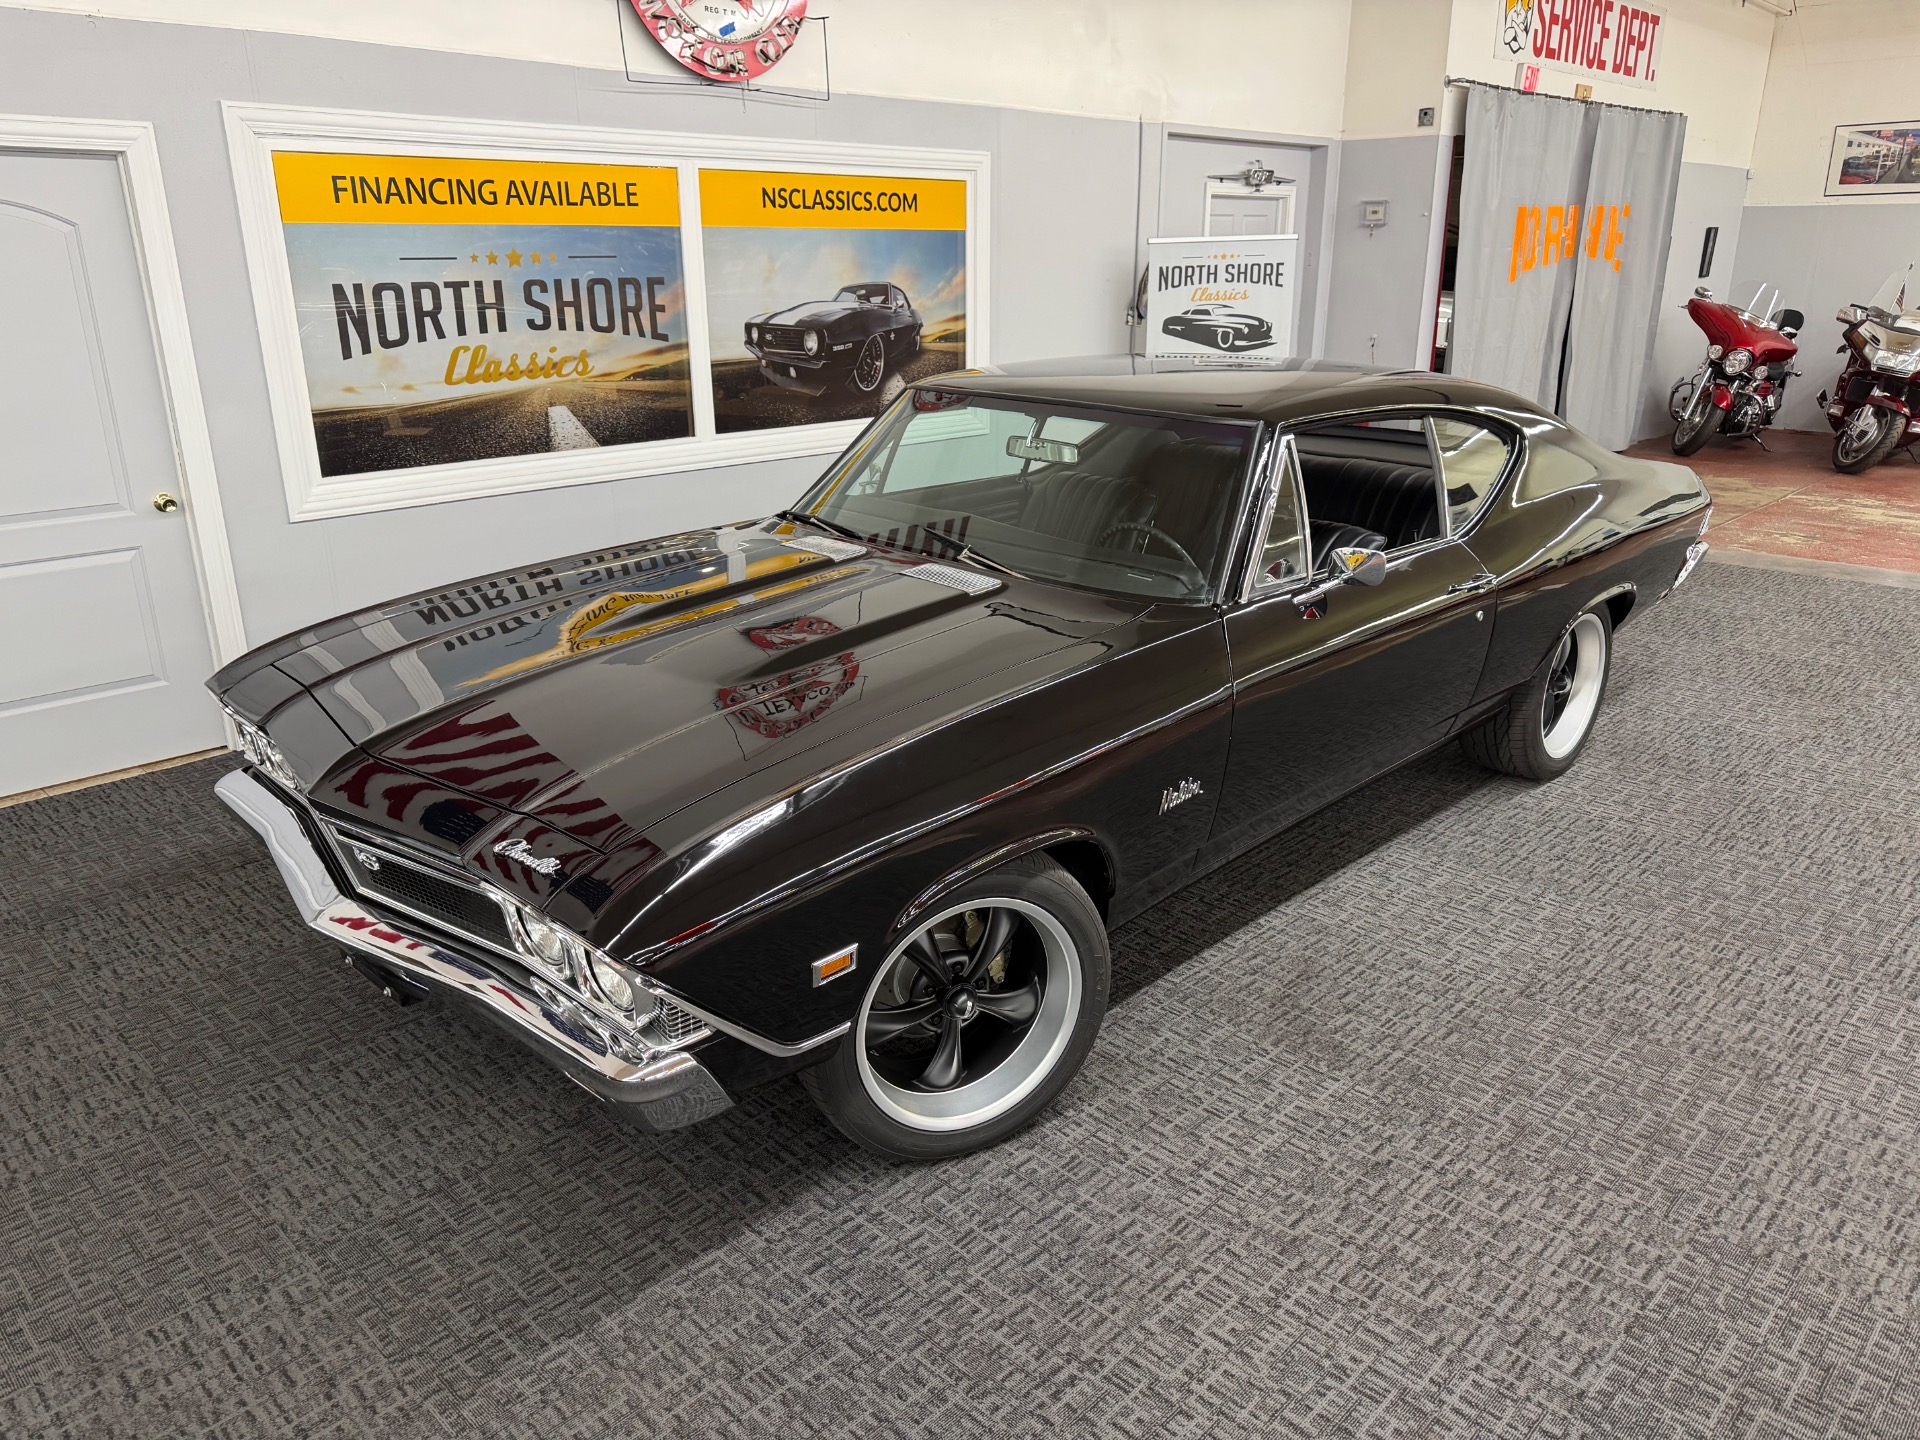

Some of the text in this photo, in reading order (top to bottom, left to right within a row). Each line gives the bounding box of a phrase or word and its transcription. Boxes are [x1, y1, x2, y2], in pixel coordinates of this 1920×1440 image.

[1532, 0, 1660, 82] SERVICE DEPT.
[331, 175, 640, 208] FINANCING AVAILABLE
[761, 187, 918, 213] NSCLASSICS.COM
[1158, 262, 1285, 292] NORTH SHORE
[1191, 287, 1249, 303] Classics
[331, 276, 670, 361] NORTH SHORE
[444, 344, 596, 386] Classics
